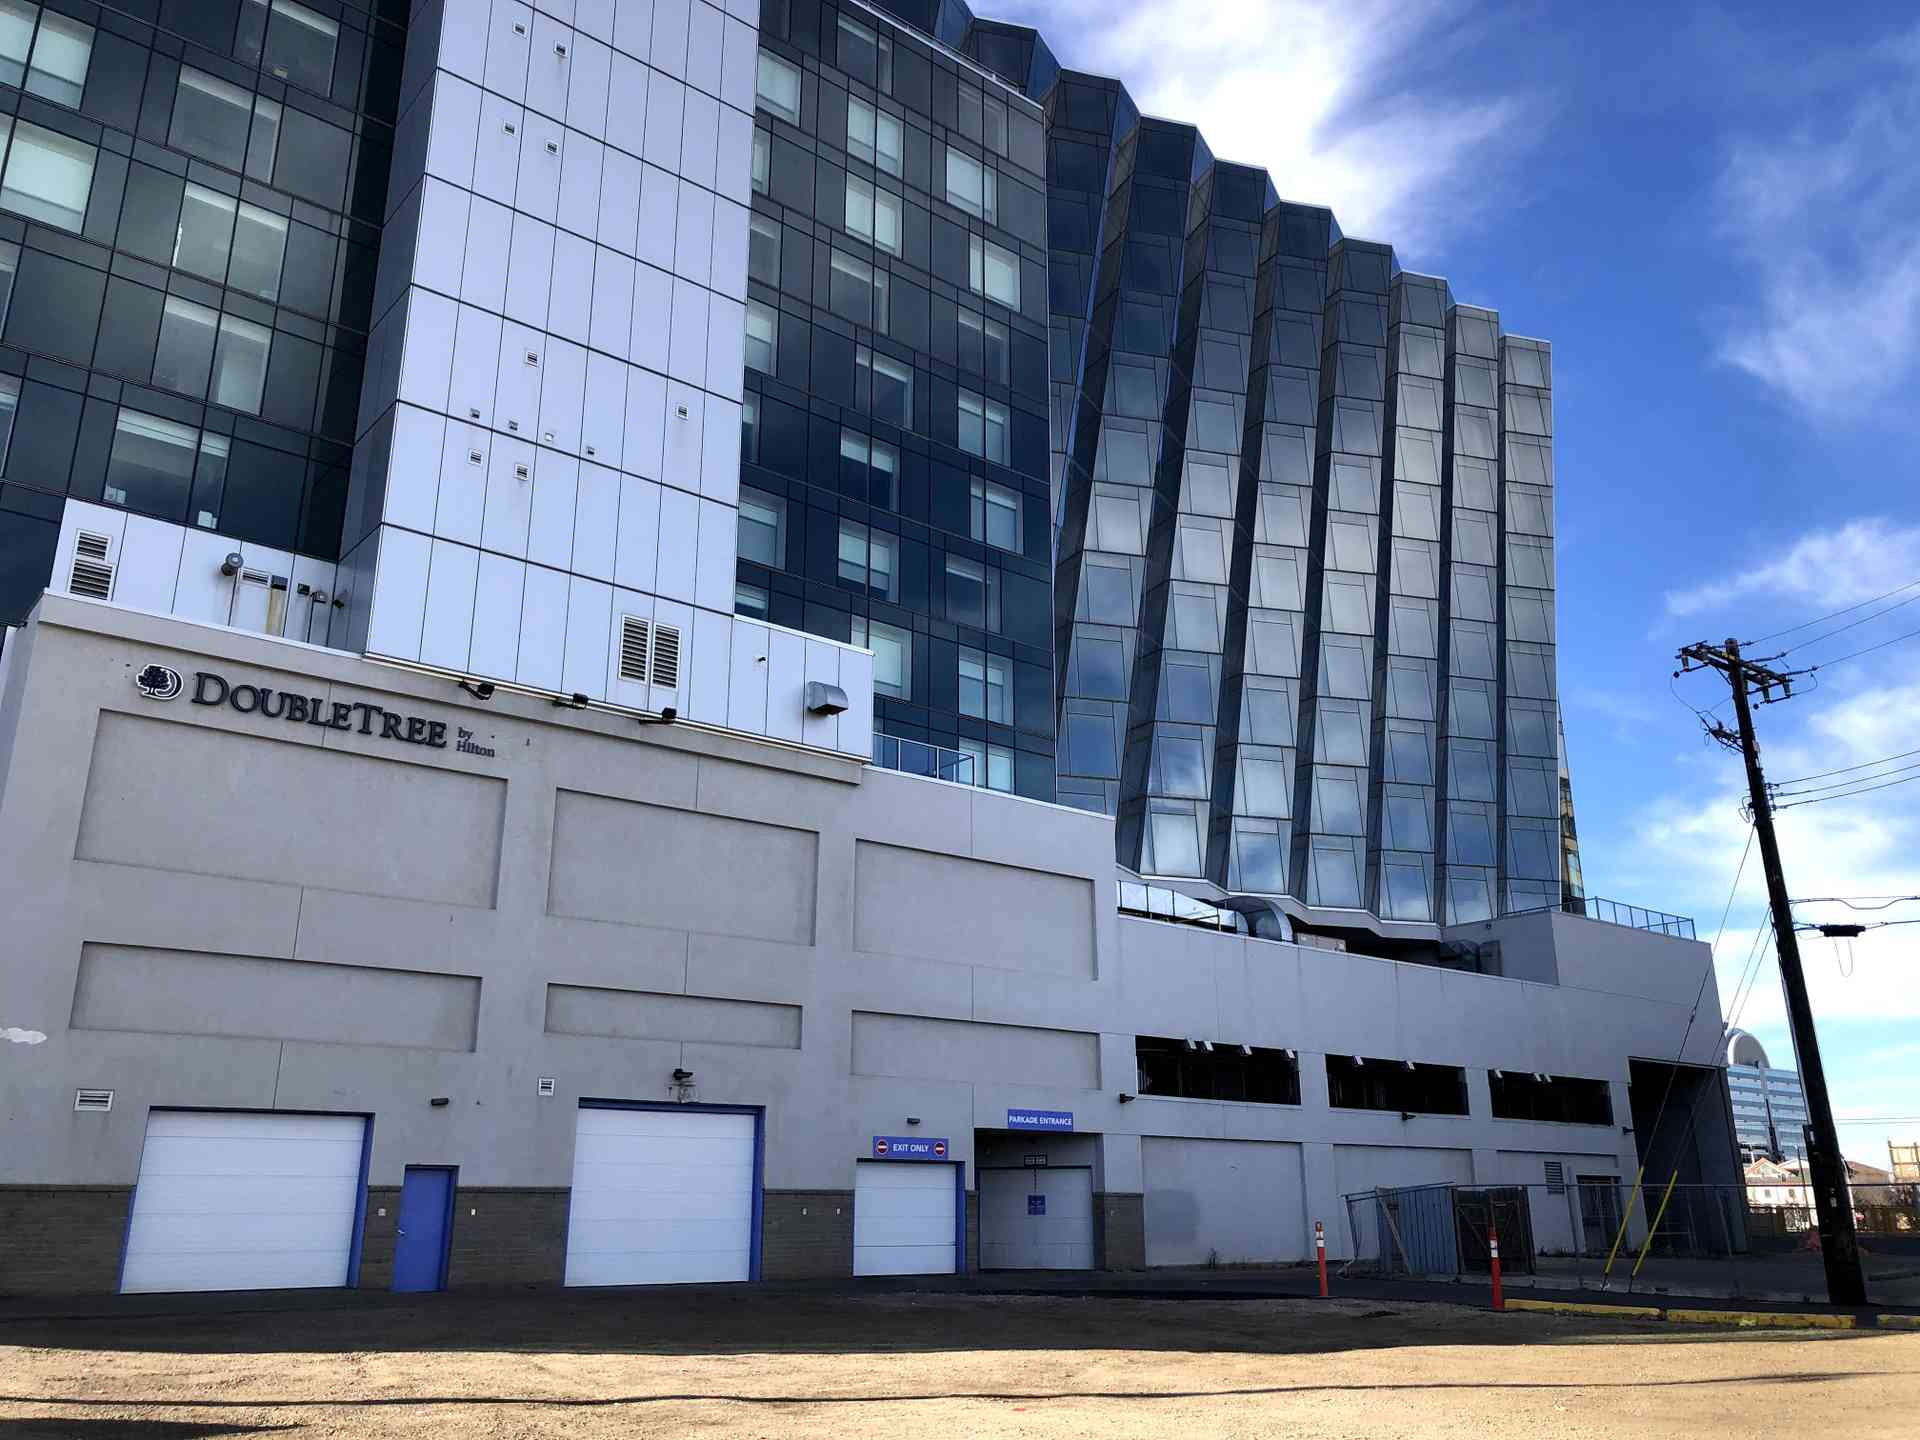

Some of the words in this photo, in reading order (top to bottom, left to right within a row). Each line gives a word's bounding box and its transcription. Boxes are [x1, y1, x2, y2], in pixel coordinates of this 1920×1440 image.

[457, 727, 473, 741] by
[456, 740, 495, 758] Hilton
[1009, 1116, 1038, 1125] PARKADE
[1040, 1117, 1072, 1126] ENTRANCE
[893, 1144, 908, 1152] EXIT
[910, 1144, 929, 1153] ONLY
